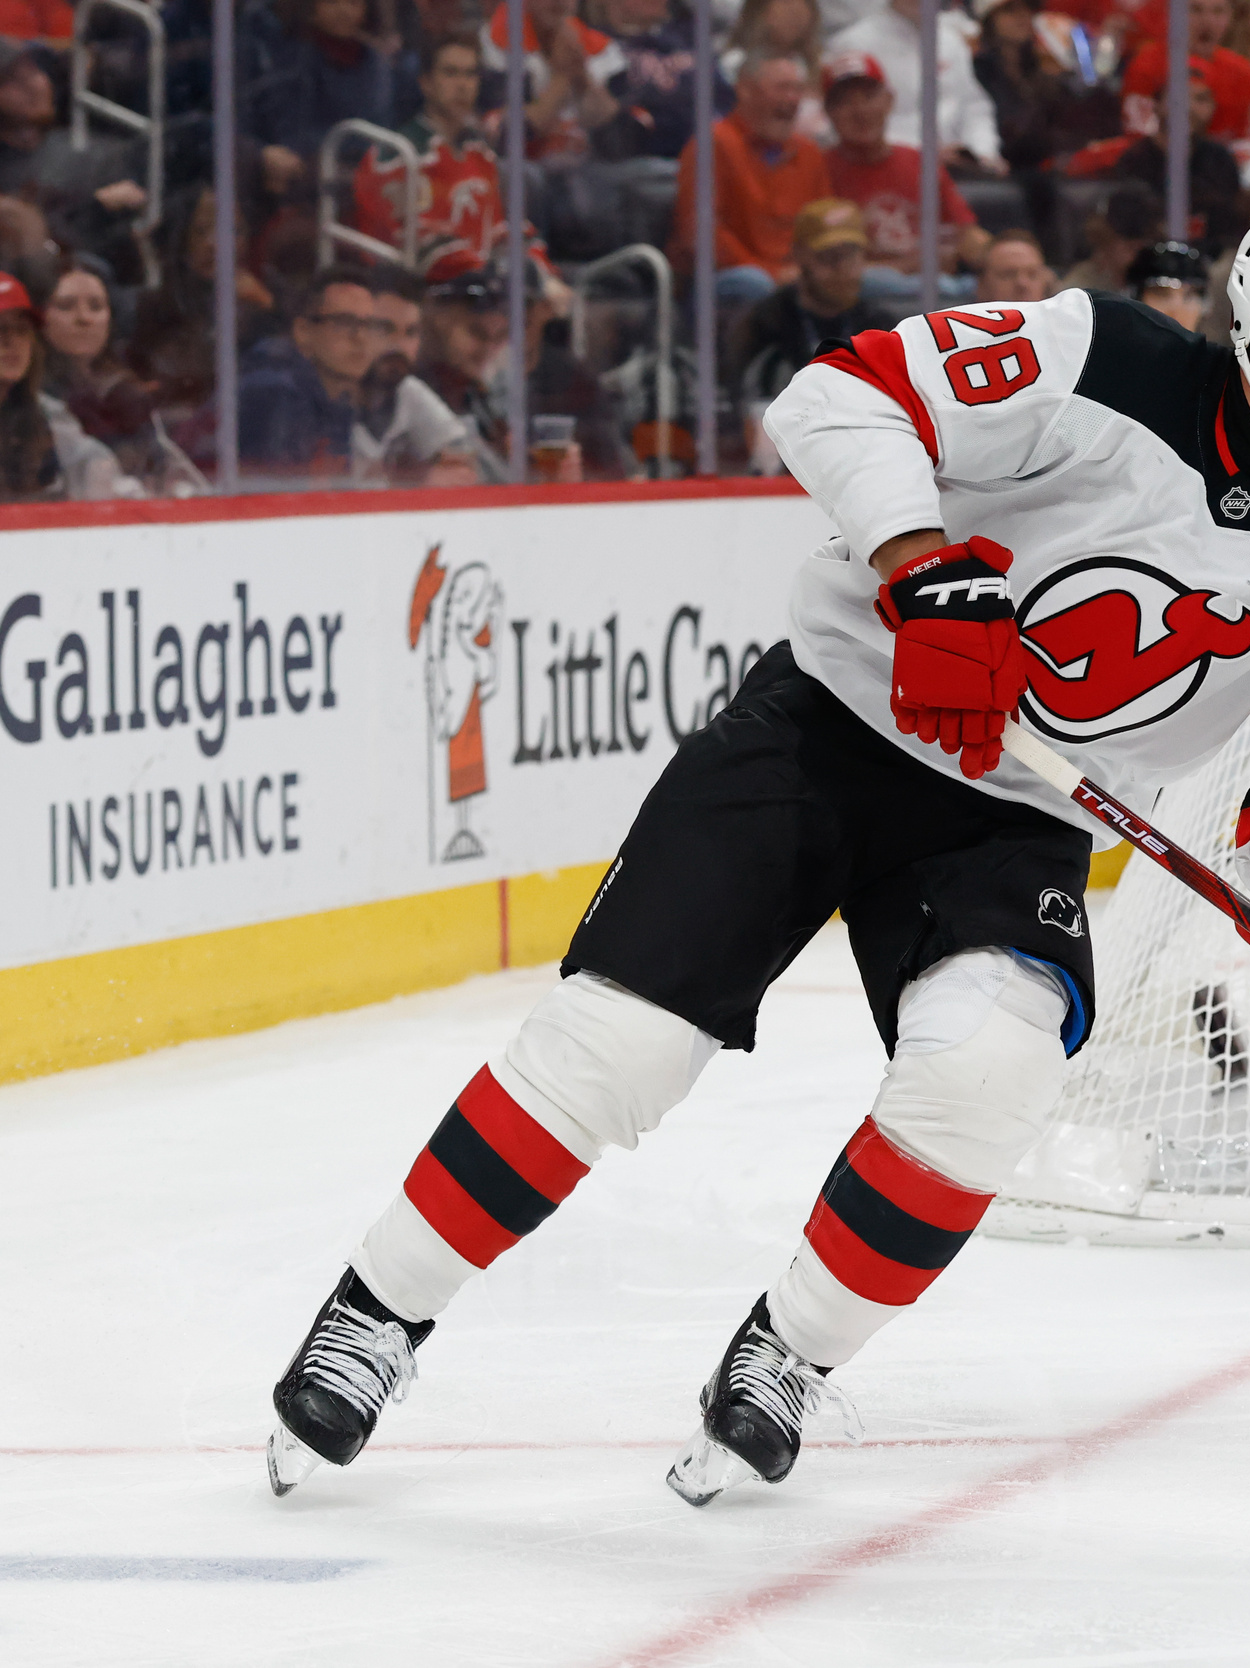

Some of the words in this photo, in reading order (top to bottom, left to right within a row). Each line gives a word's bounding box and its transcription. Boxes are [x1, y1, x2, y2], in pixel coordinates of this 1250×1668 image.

[923, 308, 1042, 407] 28
[907, 556, 942, 578] MEIER
[0, 582, 343, 758] Gallagher
[510, 611, 651, 765] Little
[50, 771, 300, 889] INSURANCE
[1079, 783, 1170, 856] TRUE
